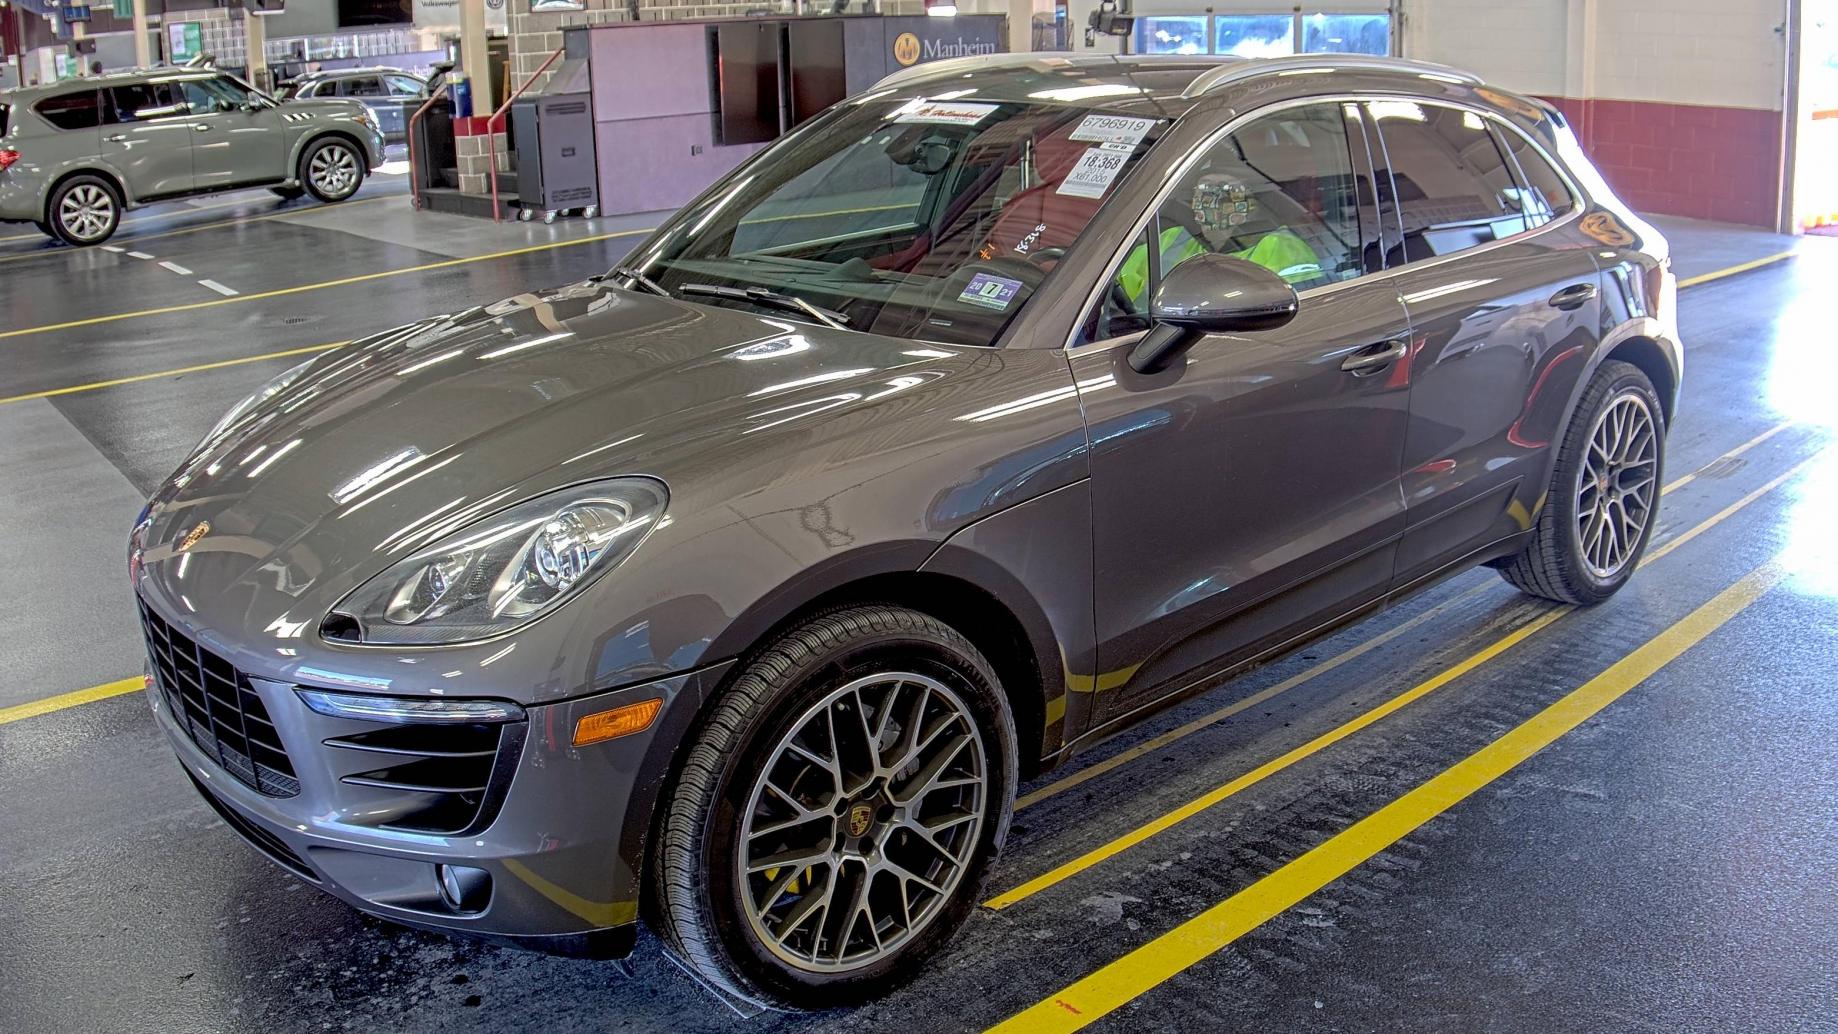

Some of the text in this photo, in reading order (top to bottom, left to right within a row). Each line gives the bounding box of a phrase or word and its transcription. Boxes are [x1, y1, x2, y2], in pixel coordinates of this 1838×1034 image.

[923, 37, 995, 59] Manheim
[1082, 117, 1146, 131] 6796919
[970, 282, 983, 290] 20
[1000, 288, 1013, 297] 21
